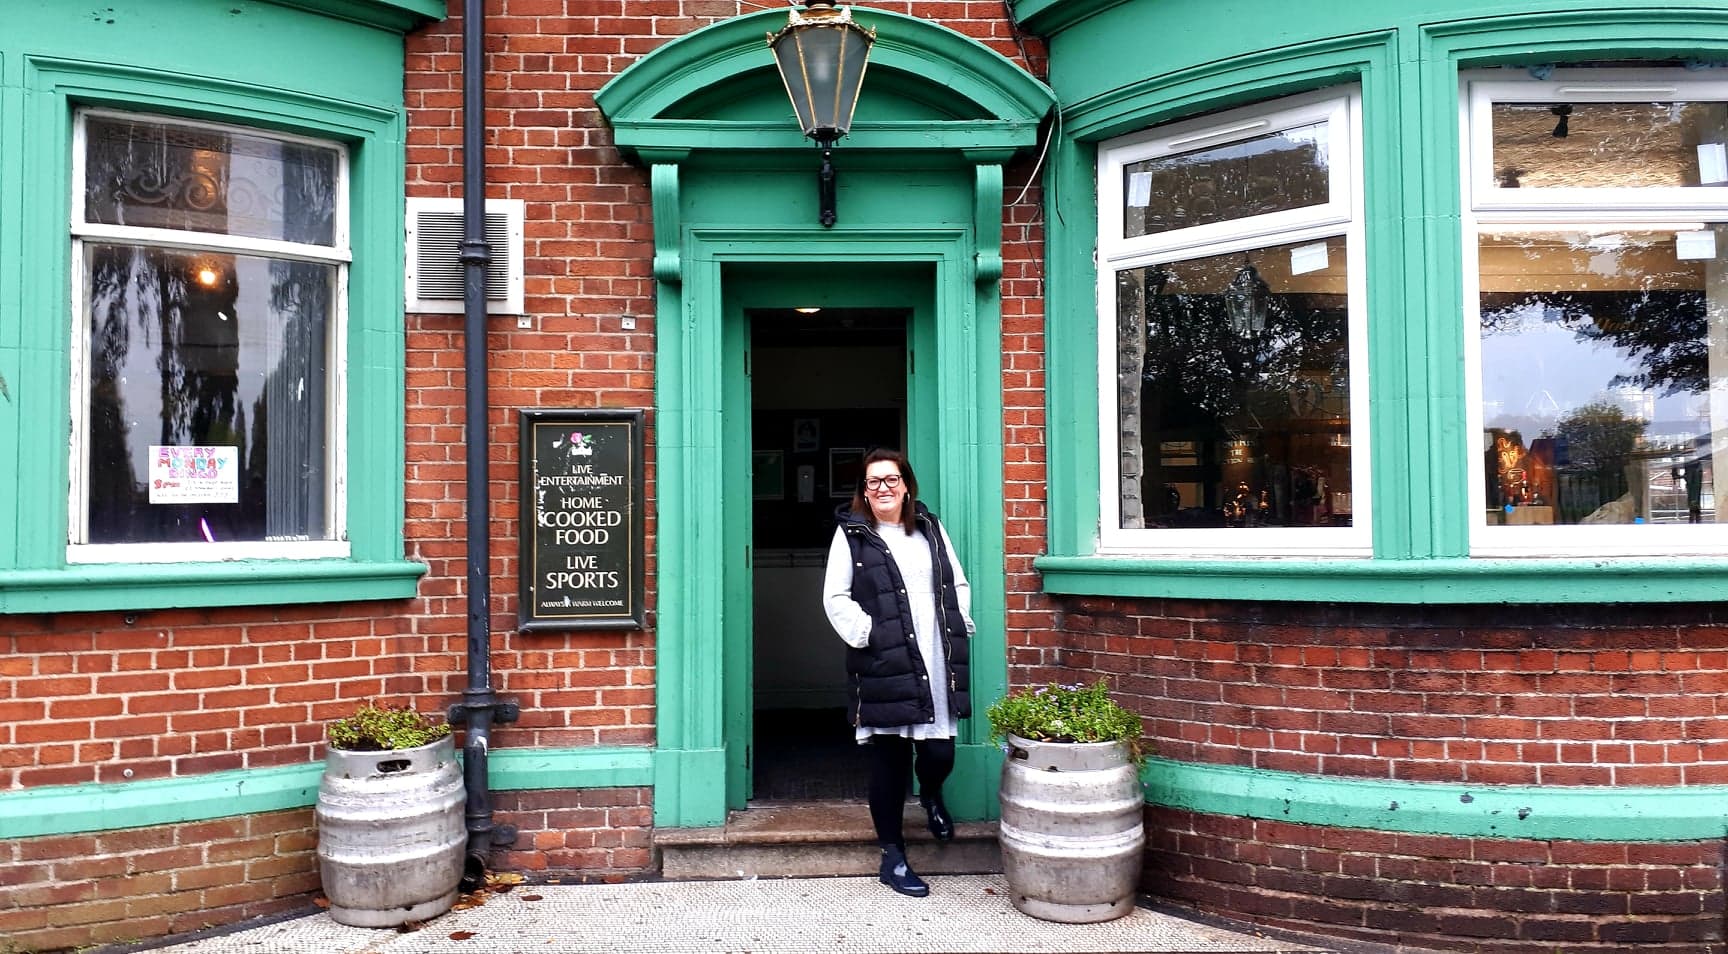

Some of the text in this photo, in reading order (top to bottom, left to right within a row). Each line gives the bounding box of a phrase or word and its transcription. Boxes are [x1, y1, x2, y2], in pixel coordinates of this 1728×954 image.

[159, 447, 216, 458] EVERY
[157, 457, 228, 470] MONDAY
[571, 464, 593, 474] LIVE
[540, 475, 624, 486] ENTERTAINMENT
[561, 496, 603, 509] HOME
[543, 510, 622, 528] COOKED
[555, 529, 609, 545] FOOD
[566, 555, 598, 570] LIVE
[545, 571, 619, 589] SPORTS
[592, 599, 624, 607] WELCOME
